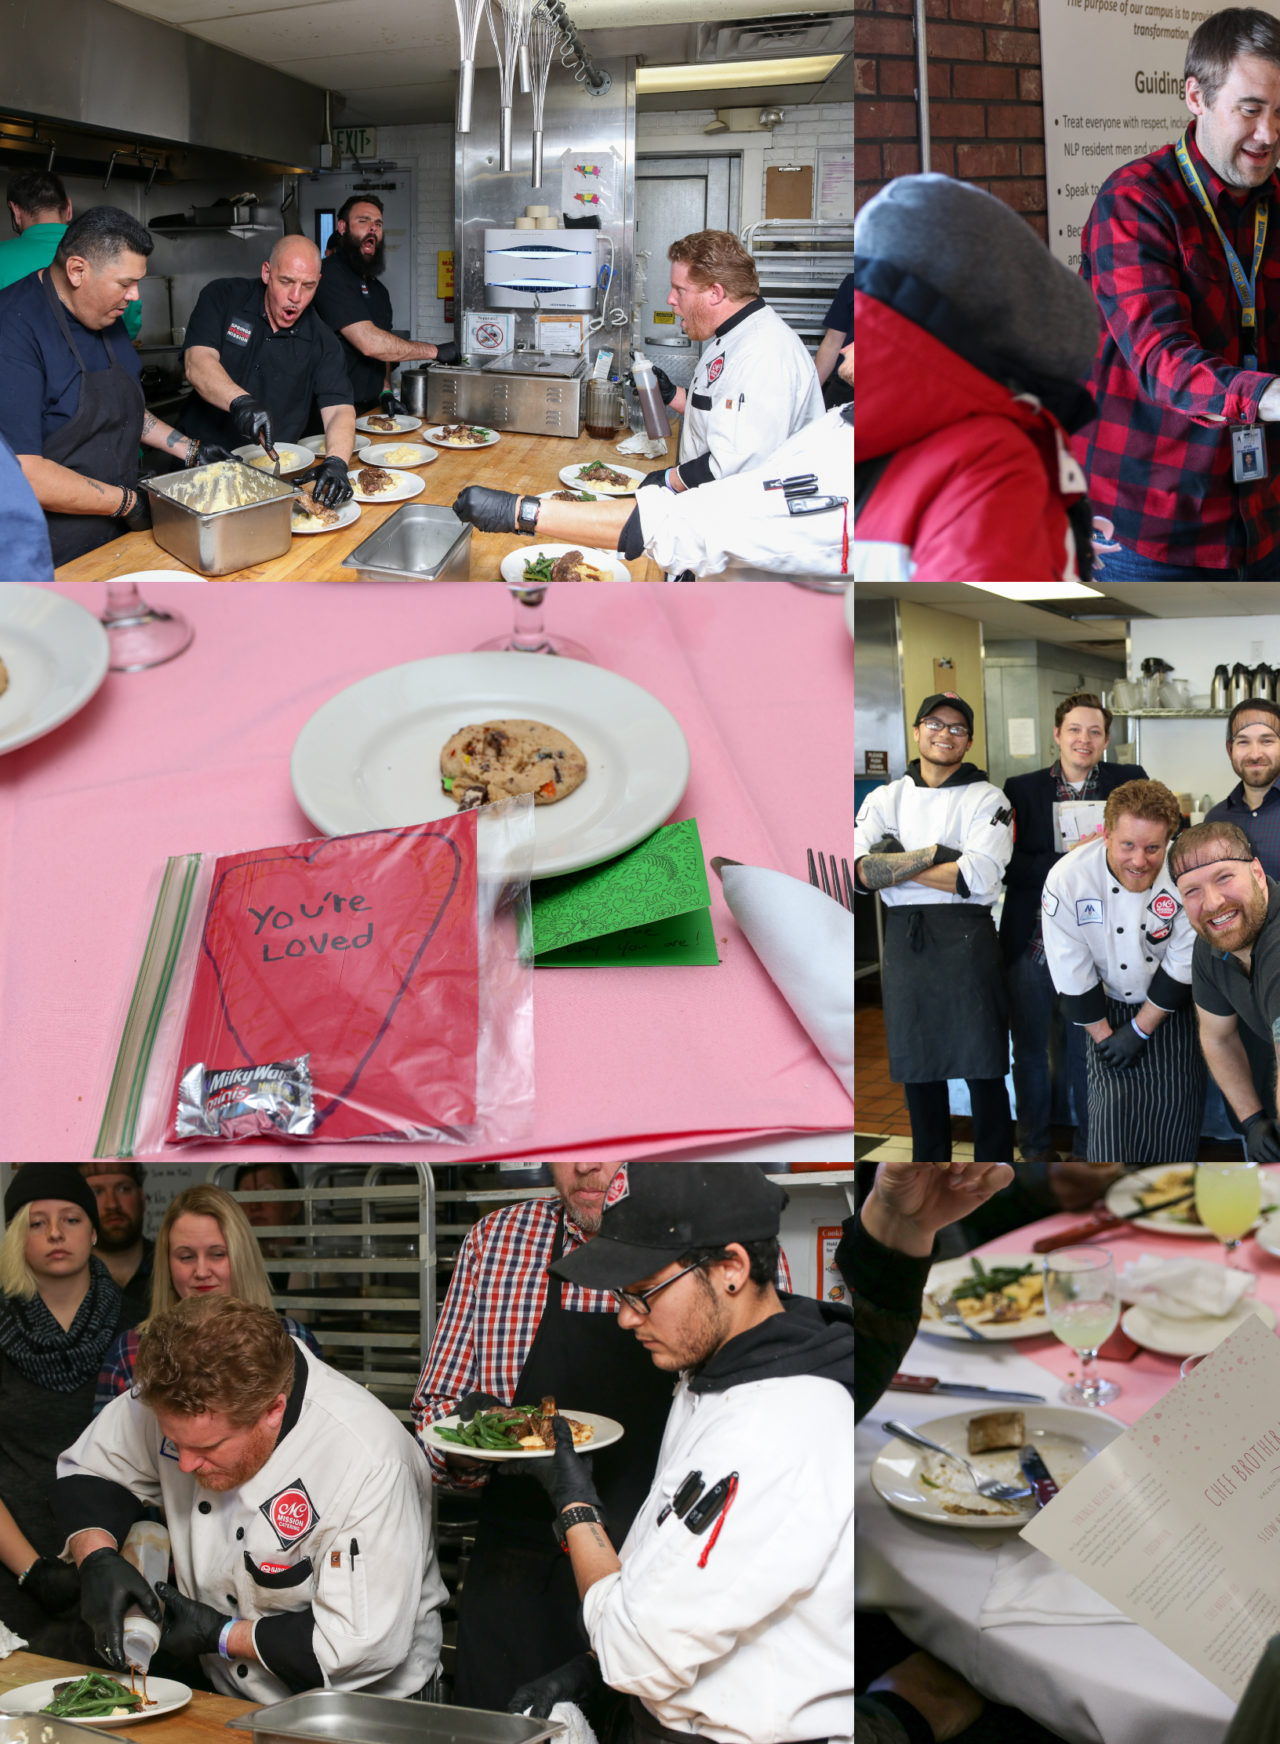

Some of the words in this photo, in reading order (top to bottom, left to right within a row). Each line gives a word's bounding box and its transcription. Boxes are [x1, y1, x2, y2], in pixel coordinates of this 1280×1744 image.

[1084, 0, 1118, 13] purpose
[1119, 0, 1129, 16] of
[1129, 3, 1144, 15] our
[1144, 5, 1173, 20] campus
[1174, 5, 1181, 19] is
[1182, 8, 1190, 20] to
[1135, 70, 1186, 100] Guiding
[1063, 115, 1084, 129] Treat
[1086, 117, 1121, 131] everyone
[1123, 116, 1139, 129] with
[1140, 118, 1169, 131] respect,
[336, 129, 367, 154] EXIT
[1064, 143, 1080, 157] NLP
[1082, 144, 1113, 156] resident
[1115, 144, 1132, 155] men
[1134, 142, 1148, 155] and
[1065, 184, 1090, 199] Speak
[1067, 225, 1083, 238] Bec
[248, 891, 374, 935] You're
[209, 1068, 255, 1093] Milky
[1204, 1473, 1237, 1507] CHEF
[277, 1514, 304, 1527] MISSION
[278, 1521, 301, 1532] CATERING
[1257, 1520, 1279, 1544] SLOW
